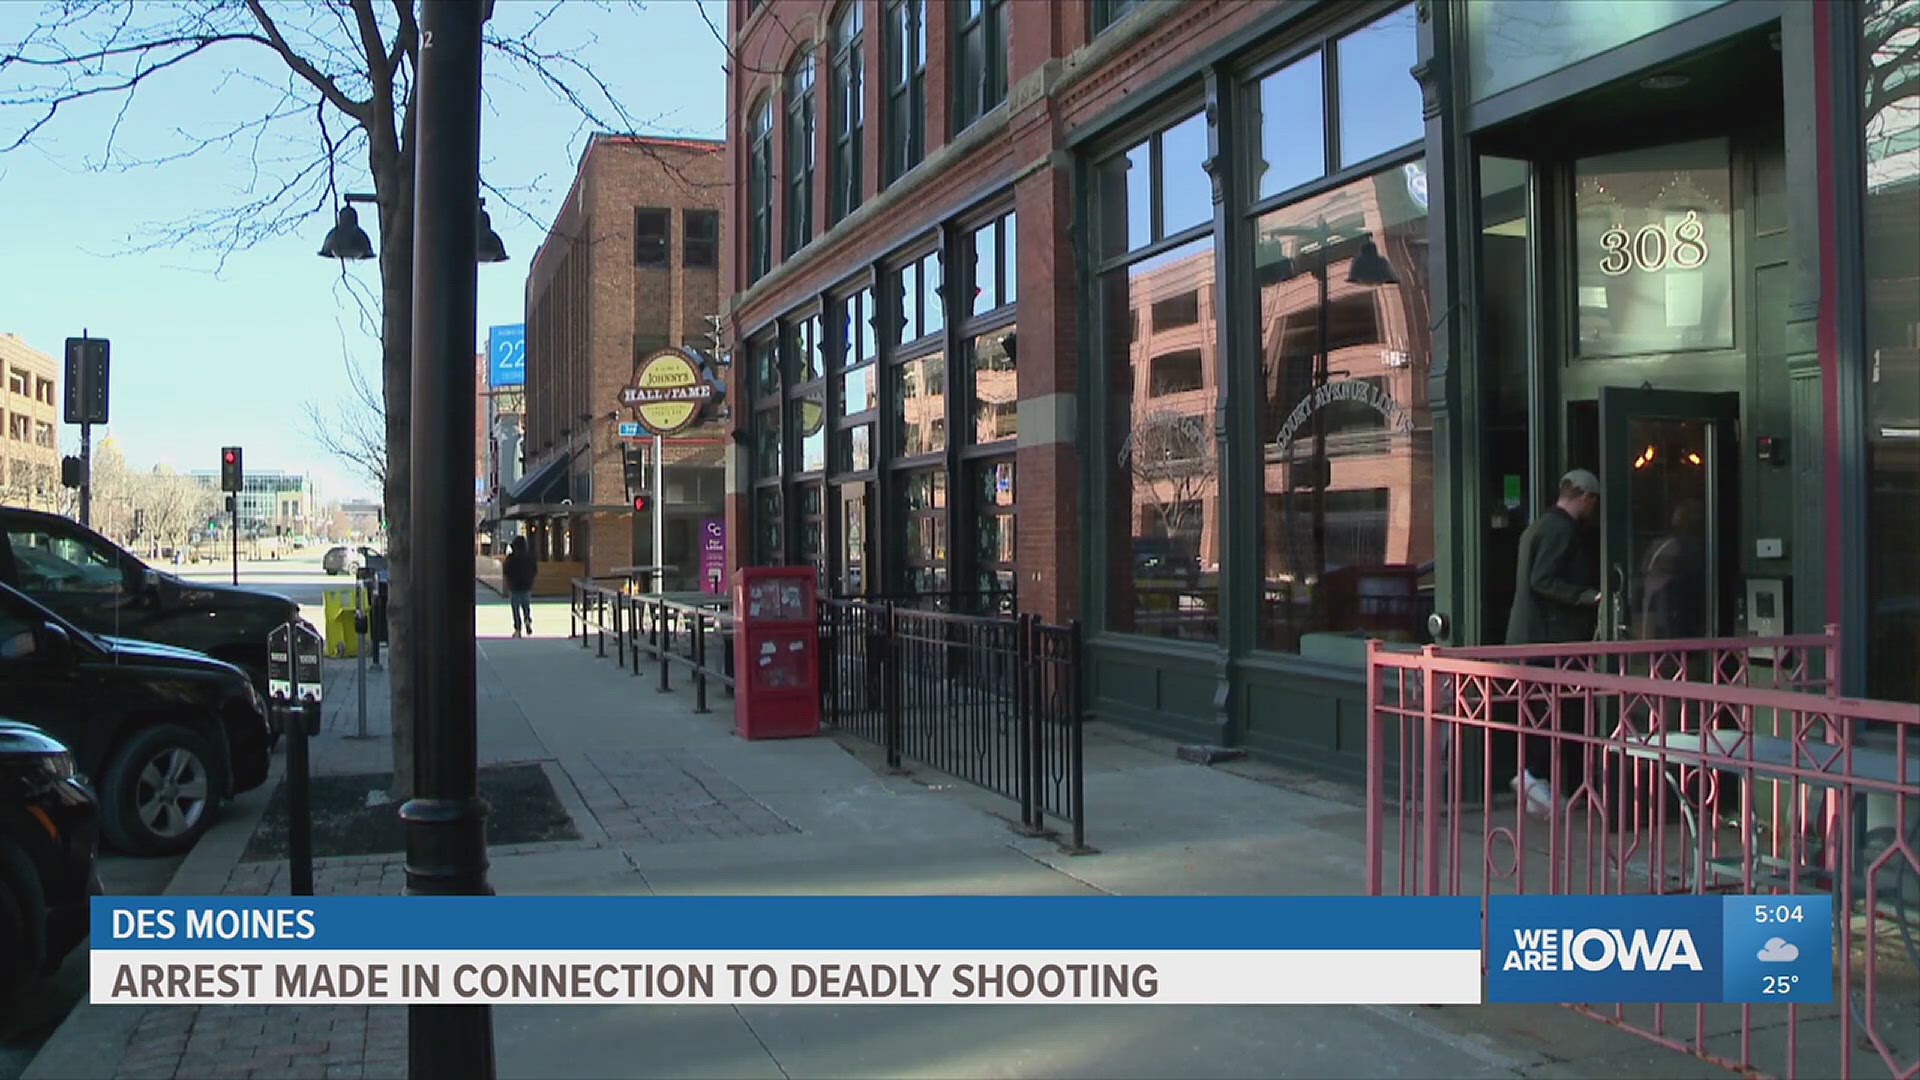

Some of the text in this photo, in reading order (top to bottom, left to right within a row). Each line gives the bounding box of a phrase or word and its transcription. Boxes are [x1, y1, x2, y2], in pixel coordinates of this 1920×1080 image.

[1600, 210, 1708, 276] 308
[624, 388, 662, 402] HALL
[671, 384, 710, 399] FAME
